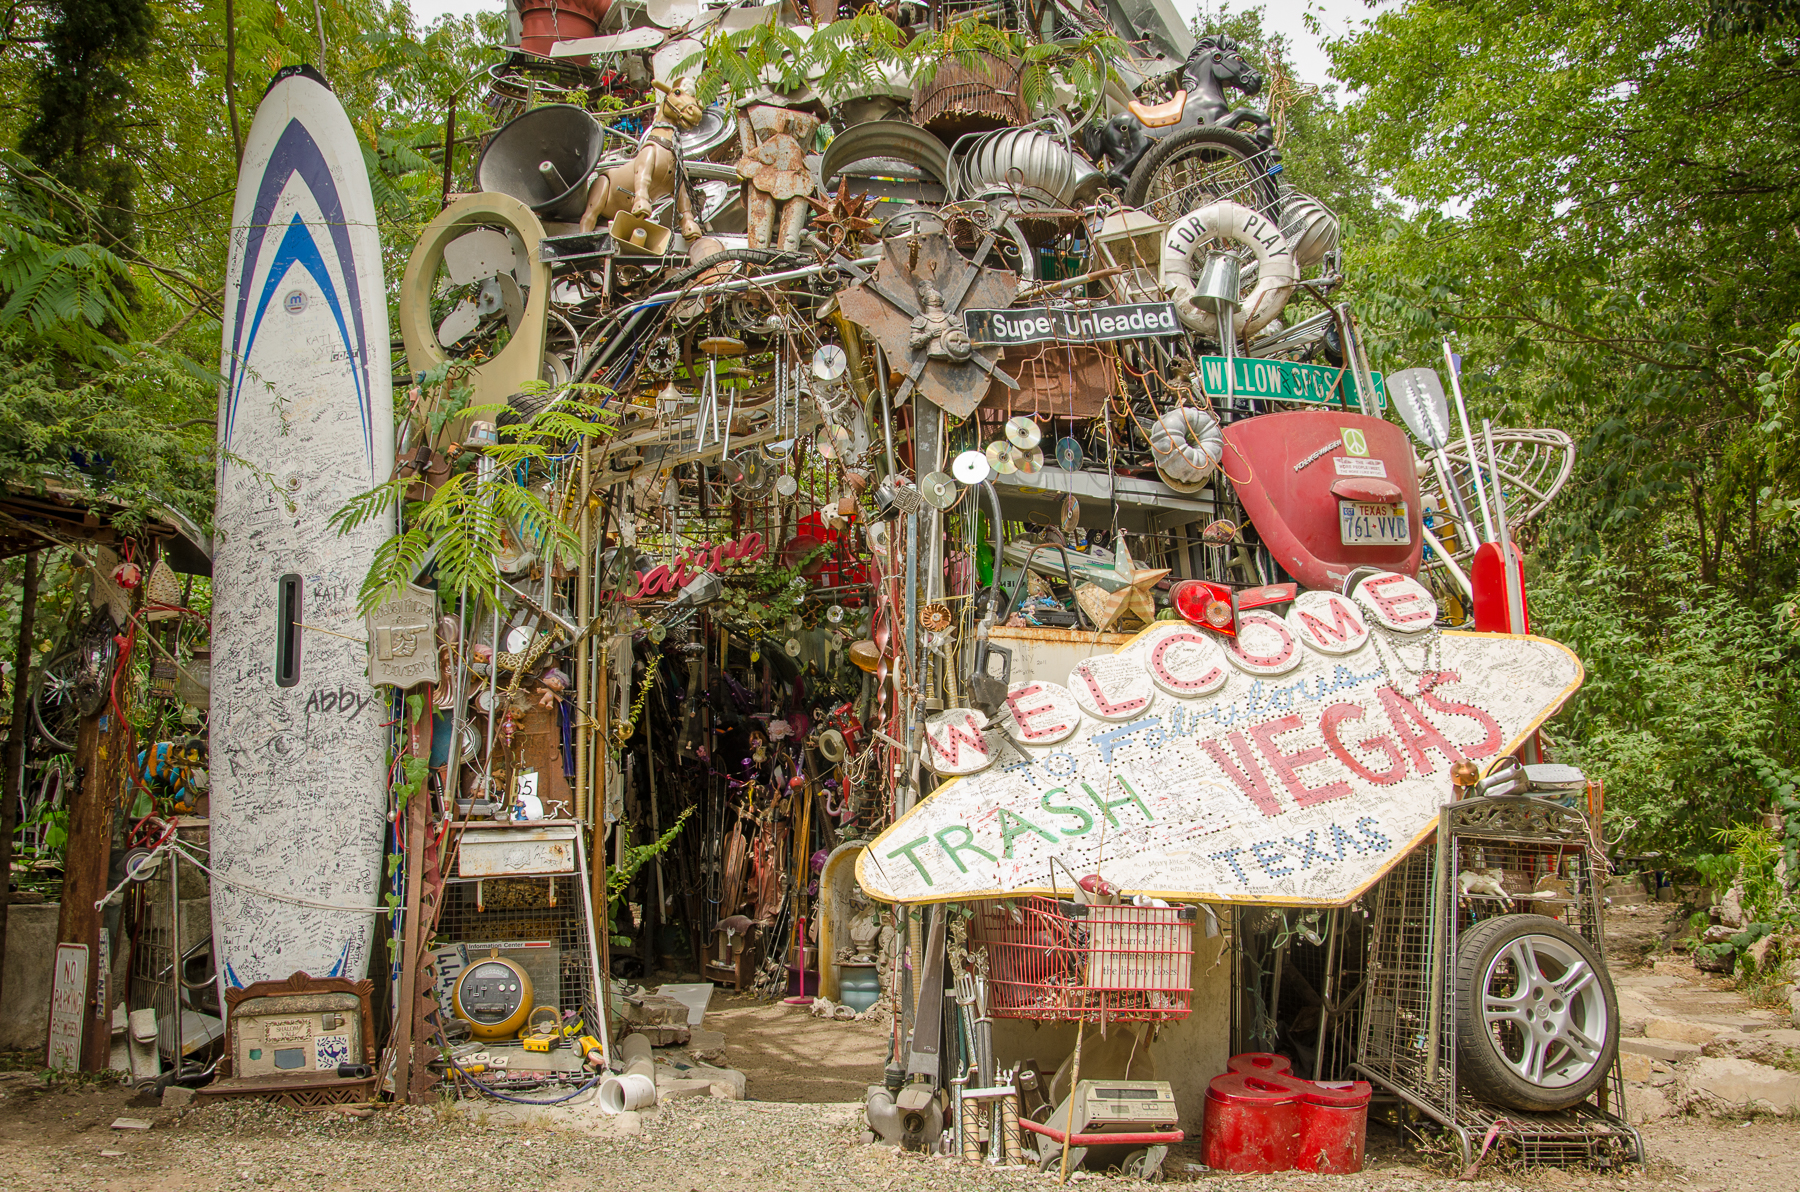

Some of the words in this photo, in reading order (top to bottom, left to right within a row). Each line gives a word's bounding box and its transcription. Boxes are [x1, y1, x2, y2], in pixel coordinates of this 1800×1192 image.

[1167, 216, 1206, 256] FOR
[1243, 214, 1290, 261] PLAY
[992, 312, 1056, 341] Super
[1063, 306, 1175, 336] Unleaded
[1205, 361, 1282, 394] WLLOW
[1344, 517, 1372, 538] 761
[1359, 505, 1387, 516] TEXAS
[603, 533, 766, 601] arine
[380, 653, 430, 677] TAVERN
[923, 574, 1431, 767] WELCOME
[304, 684, 372, 722] Abby
[1004, 752, 1077, 786] TO
[1091, 665, 1384, 764] Fabulous
[886, 774, 1155, 887] TRASH
[1200, 670, 1503, 816] VEGAS
[1209, 817, 1390, 884] TEXAS
[1106, 934, 1117, 945] be
[64, 959, 78, 985] NO
[54, 988, 83, 1015] PARKING
